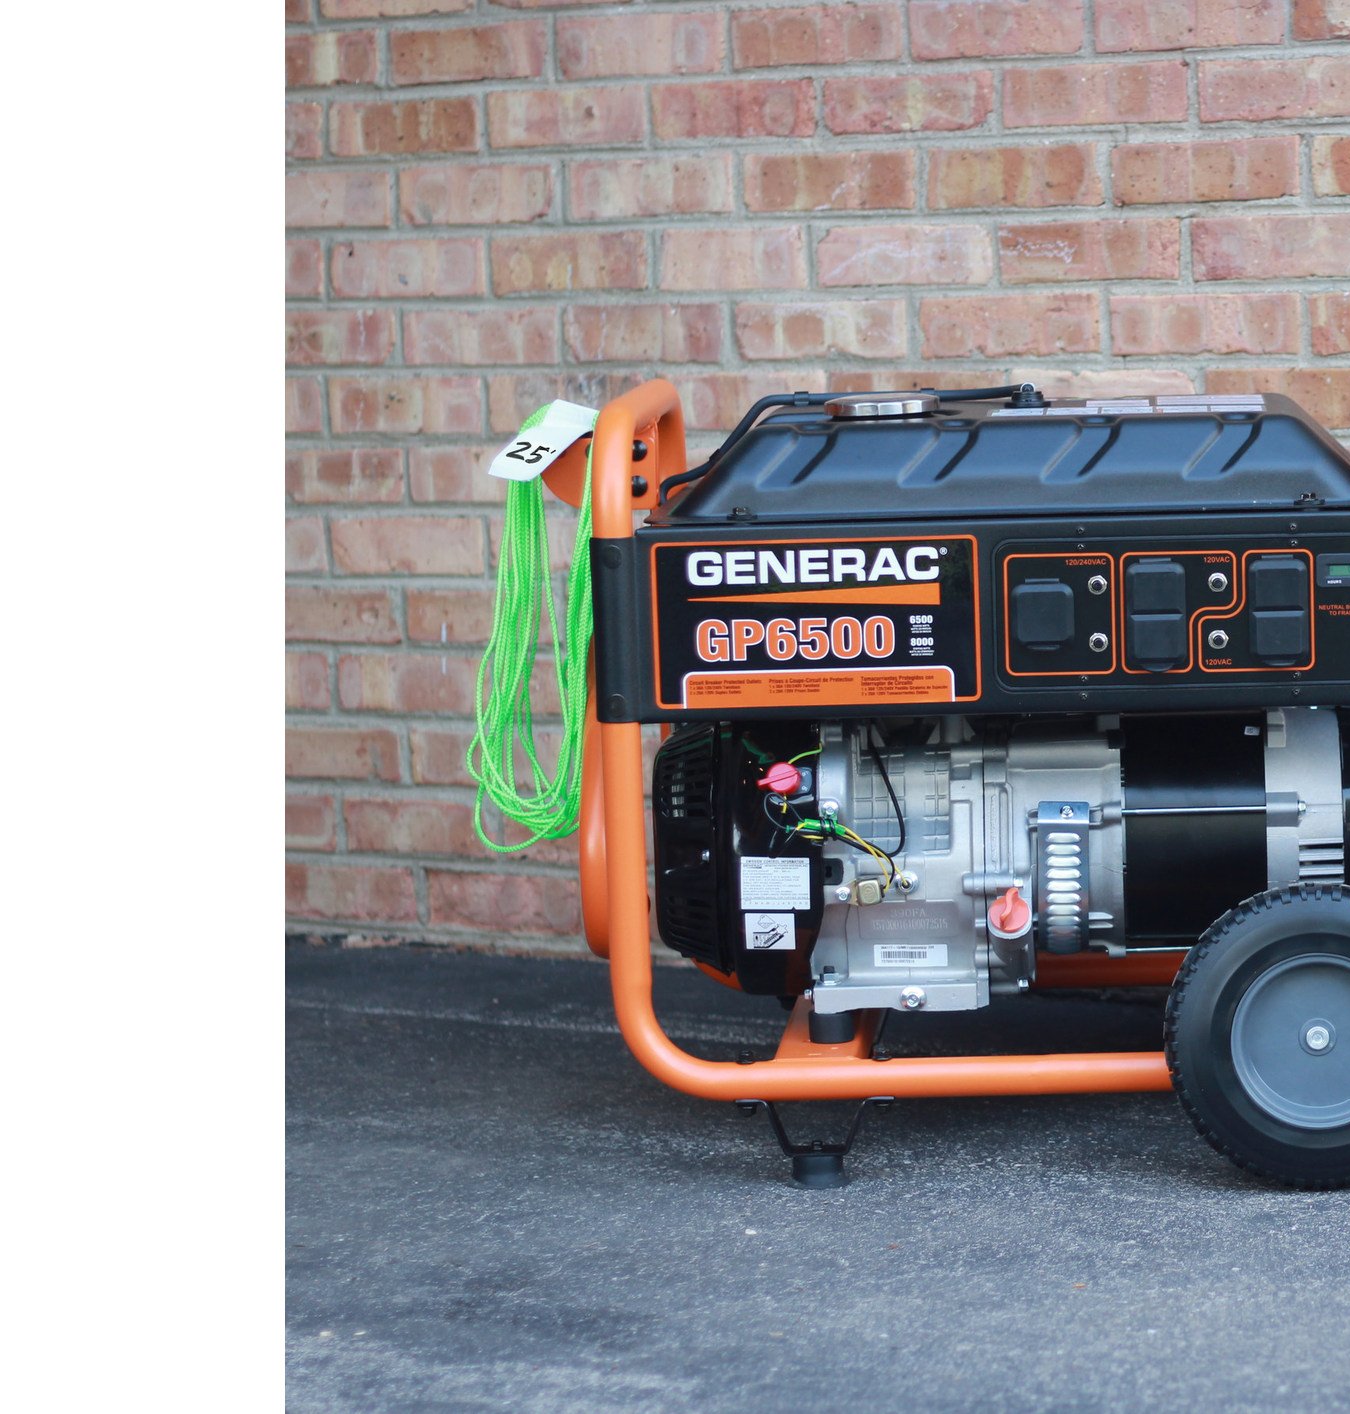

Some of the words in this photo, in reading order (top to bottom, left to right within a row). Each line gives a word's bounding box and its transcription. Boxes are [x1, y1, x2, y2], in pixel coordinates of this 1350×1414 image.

[506, 441, 556, 464] 25'
[687, 546, 939, 586] GENERAC
[1065, 558, 1107, 566] 120/240VAC
[909, 615, 933, 624] 6500
[696, 615, 895, 662] GP6500
[910, 637, 934, 647] 8000
[1205, 658, 1233, 666] 120VAC
